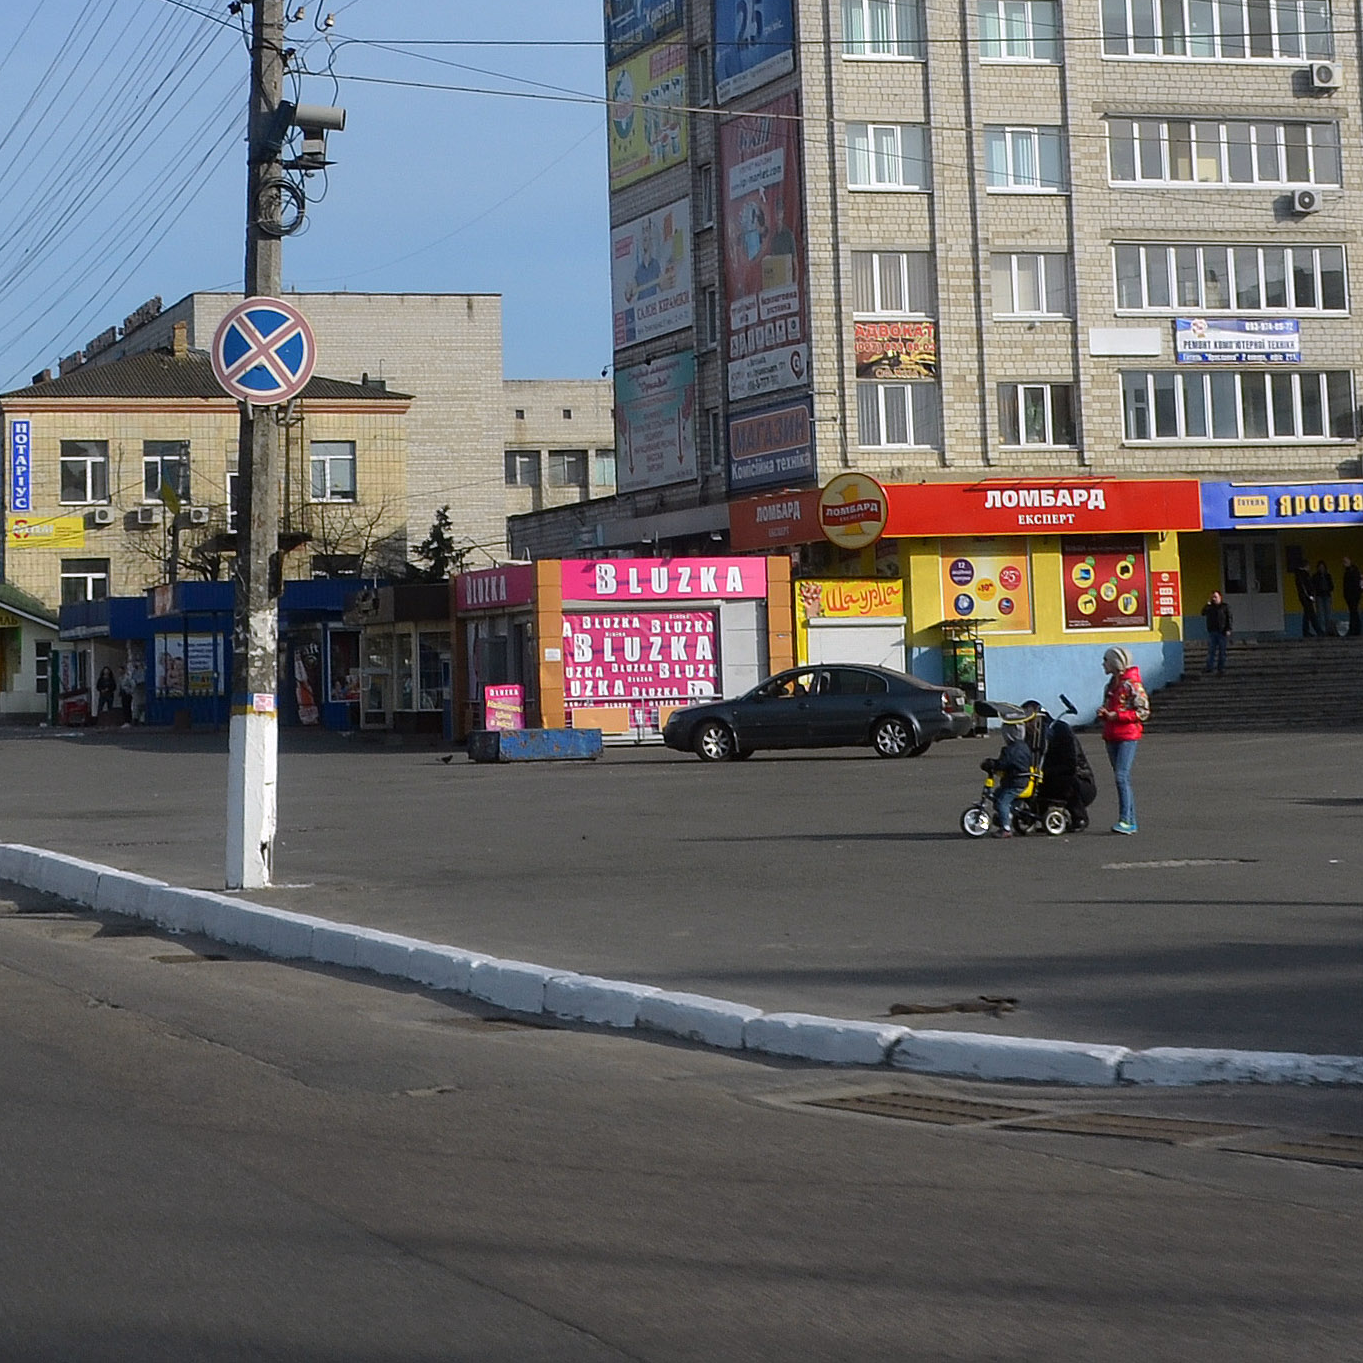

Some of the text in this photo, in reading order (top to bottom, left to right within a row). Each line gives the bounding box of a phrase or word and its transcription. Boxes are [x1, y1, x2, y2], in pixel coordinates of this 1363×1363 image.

[854, 324, 935, 339] АДВОКАТ
[1183, 340, 1211, 349] РЕМОНТ
[15, 423, 28, 508] НОТАРІУС
[732, 451, 811, 479] Комісійна техніка
[984, 488, 1106, 510] ЛОМБАРД
[756, 501, 801, 523] ЛОМБАРД
[825, 502, 879, 517] ЛОМБАРД
[1017, 513, 1075, 526] ЕКСПЕРТ
[595, 563, 745, 595] BLUZKA
[465, 574, 507, 605] BLUZKA
[826, 582, 900, 614] Шаурма
[582, 616, 640, 629] BLUZKA
[651, 619, 713, 633] BLUZKA
[574, 633, 713, 663] BLUZKA
[611, 663, 653, 673] BLUZKA
[489, 688, 519, 697] BLUZKA
[563, 679, 625, 696] UZKA
[632, 686, 679, 697] BLUZKA
